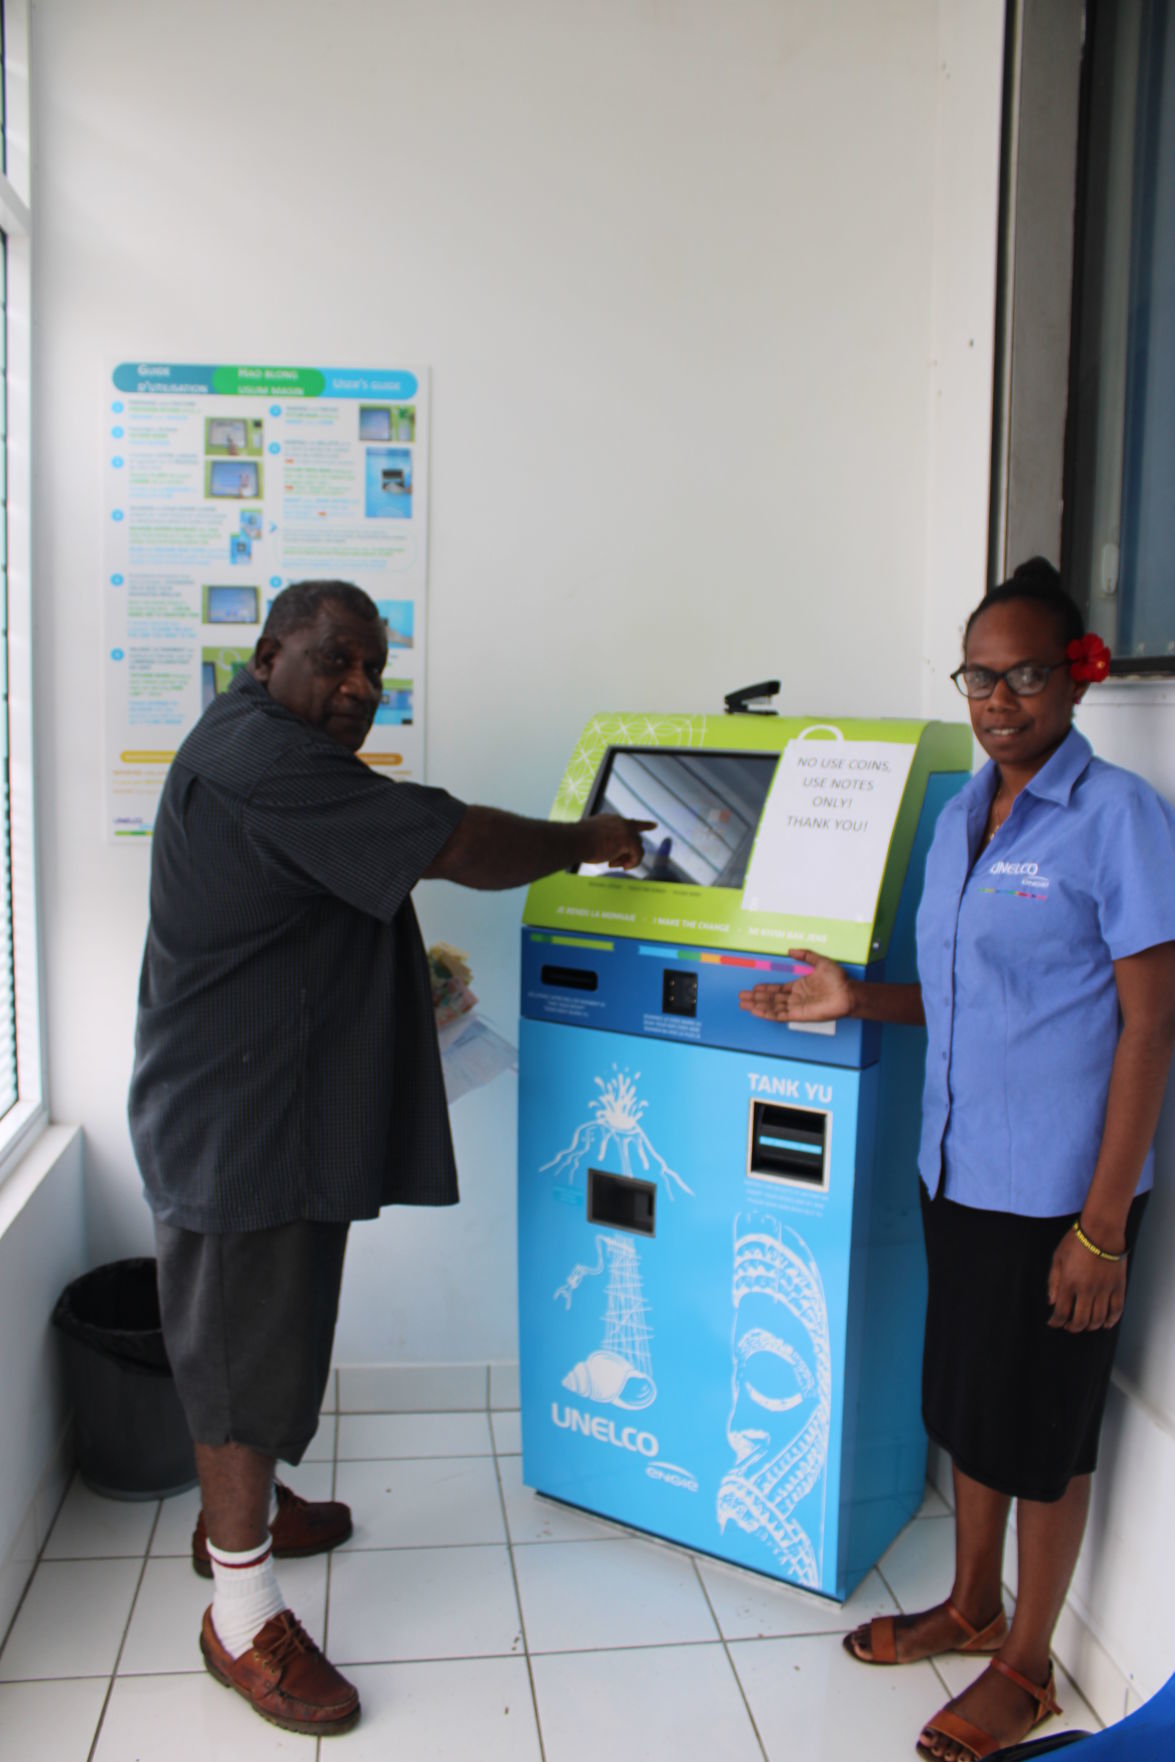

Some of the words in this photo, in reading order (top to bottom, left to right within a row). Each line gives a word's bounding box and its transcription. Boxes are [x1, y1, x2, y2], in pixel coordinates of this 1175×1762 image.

[797, 757, 818, 768] NO
[820, 758, 845, 769] USE
[802, 776, 828, 788] USE
[830, 778, 875, 791] NOTES
[812, 796, 853, 809] ONLY!
[786, 815, 831, 829] THANK
[834, 819, 869, 832] YOU!
[747, 1072, 800, 1098] TANK
[804, 1081, 833, 1104] YU
[552, 1402, 660, 1457] UNELCO
